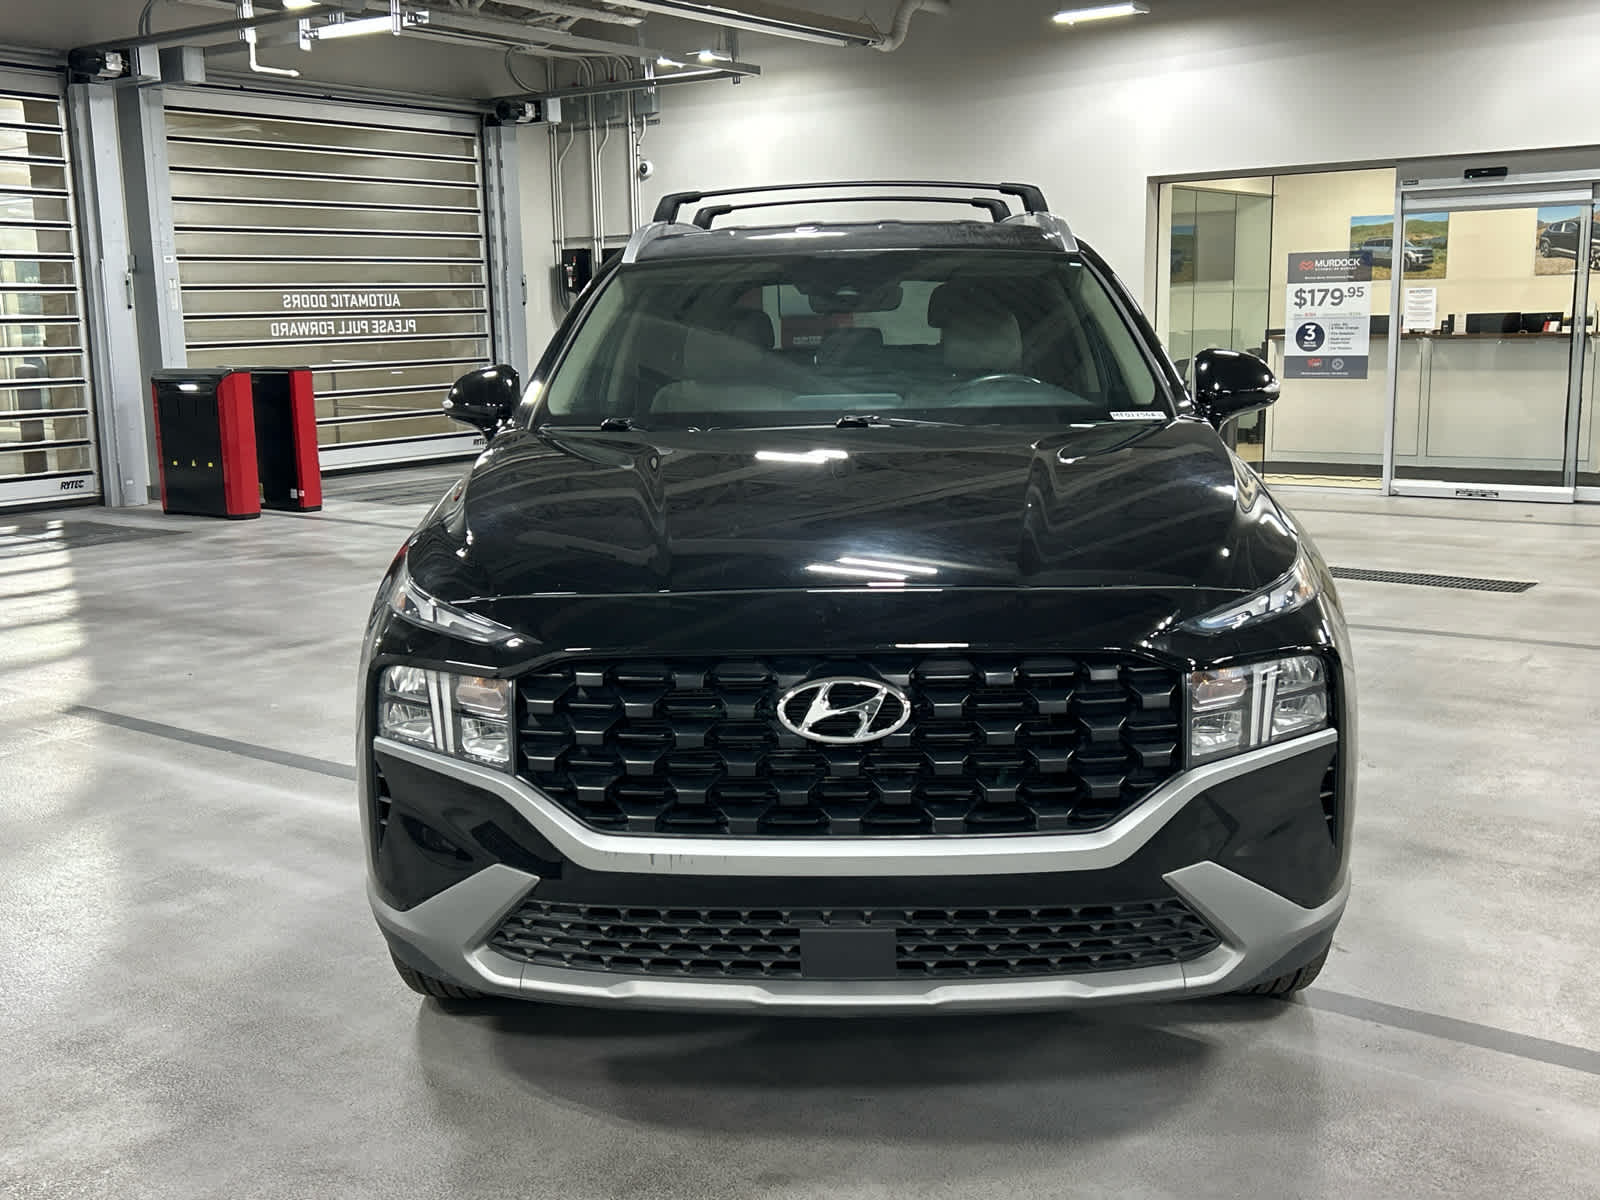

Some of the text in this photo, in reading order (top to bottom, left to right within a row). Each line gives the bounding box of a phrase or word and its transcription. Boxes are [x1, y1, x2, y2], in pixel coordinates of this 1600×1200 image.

[1315, 258, 1360, 267] MURDOCK
[1294, 286, 1364, 309] $179.95
[1304, 325, 1316, 340] 3
[60, 480, 84, 490] RYTEC
